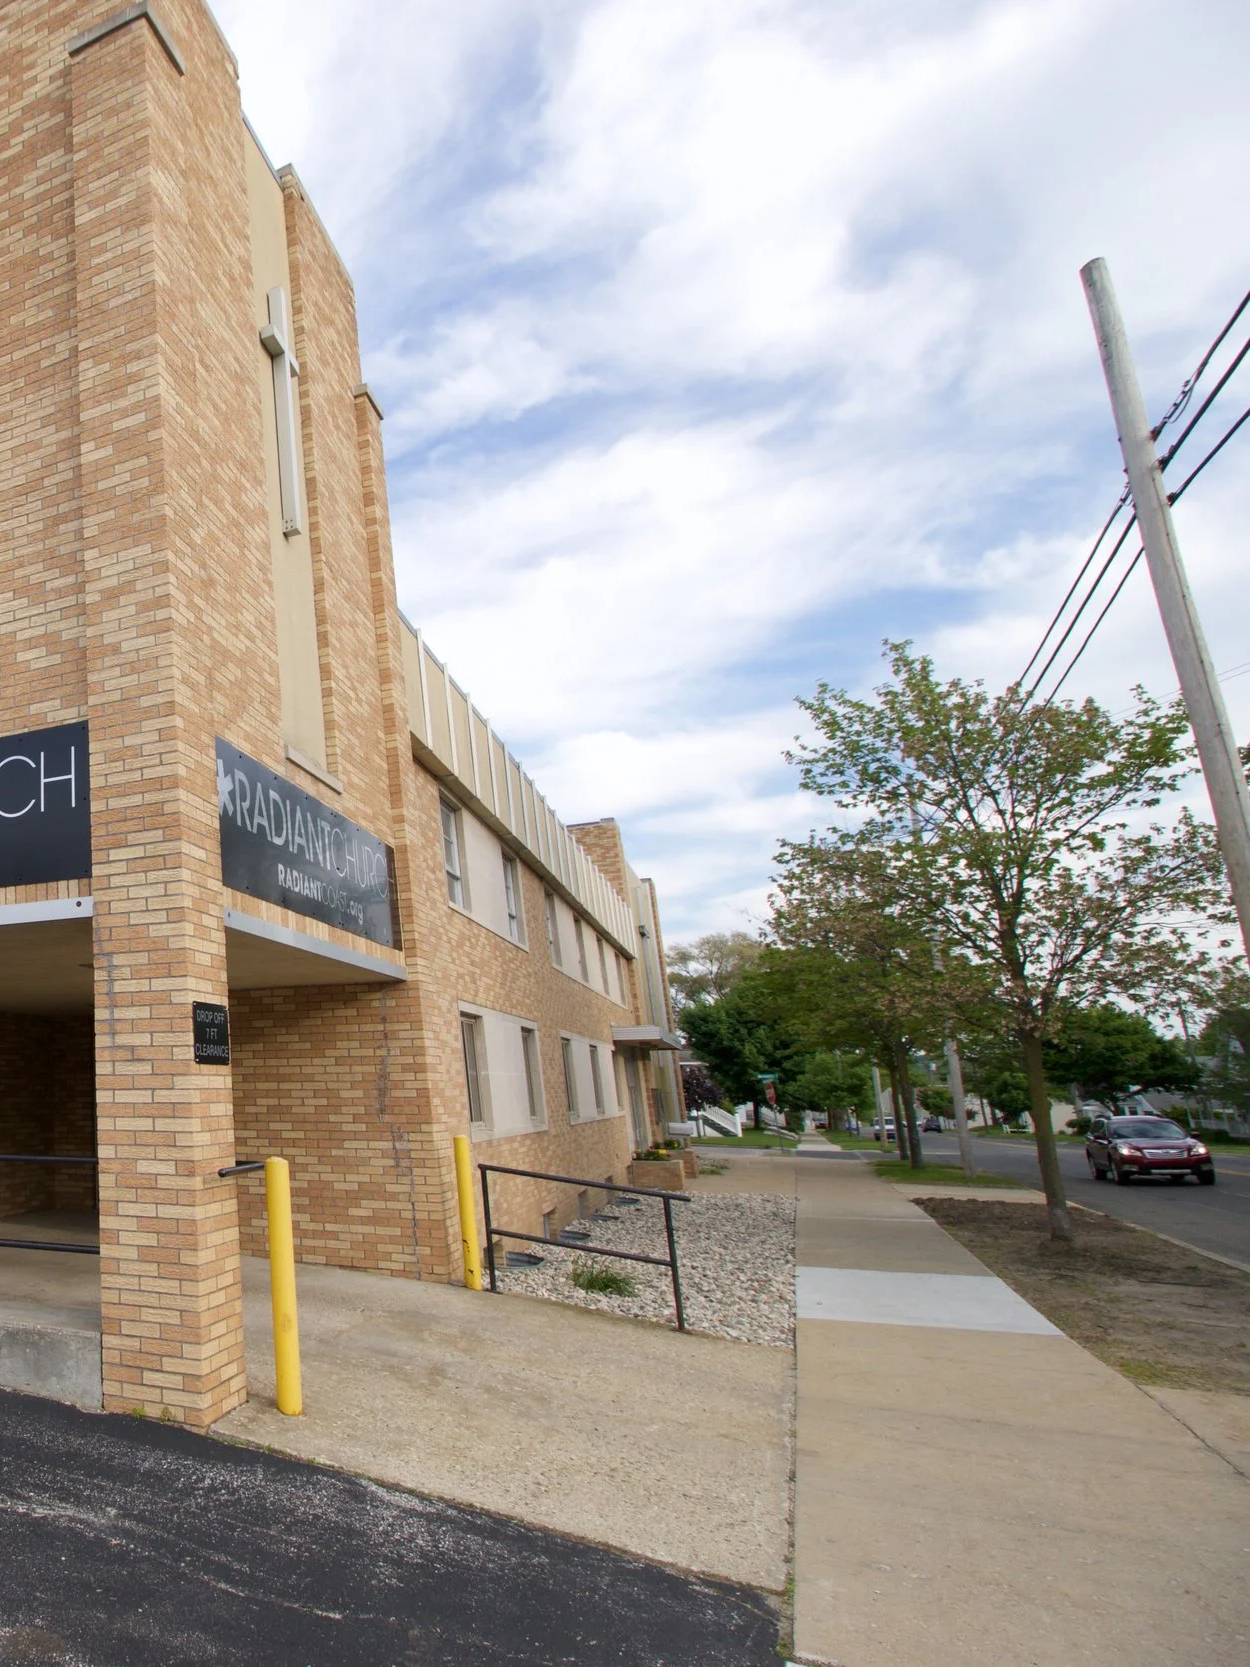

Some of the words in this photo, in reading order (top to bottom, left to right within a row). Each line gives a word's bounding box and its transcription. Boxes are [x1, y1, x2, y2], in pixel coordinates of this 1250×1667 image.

[277, 862, 364, 926] RADIANTCOAST.org
[196, 1009, 213, 1023] DROP
[213, 1012, 225, 1024] OFF
[210, 1028, 218, 1040] FT
[195, 1043, 229, 1057] CLEARANCE
